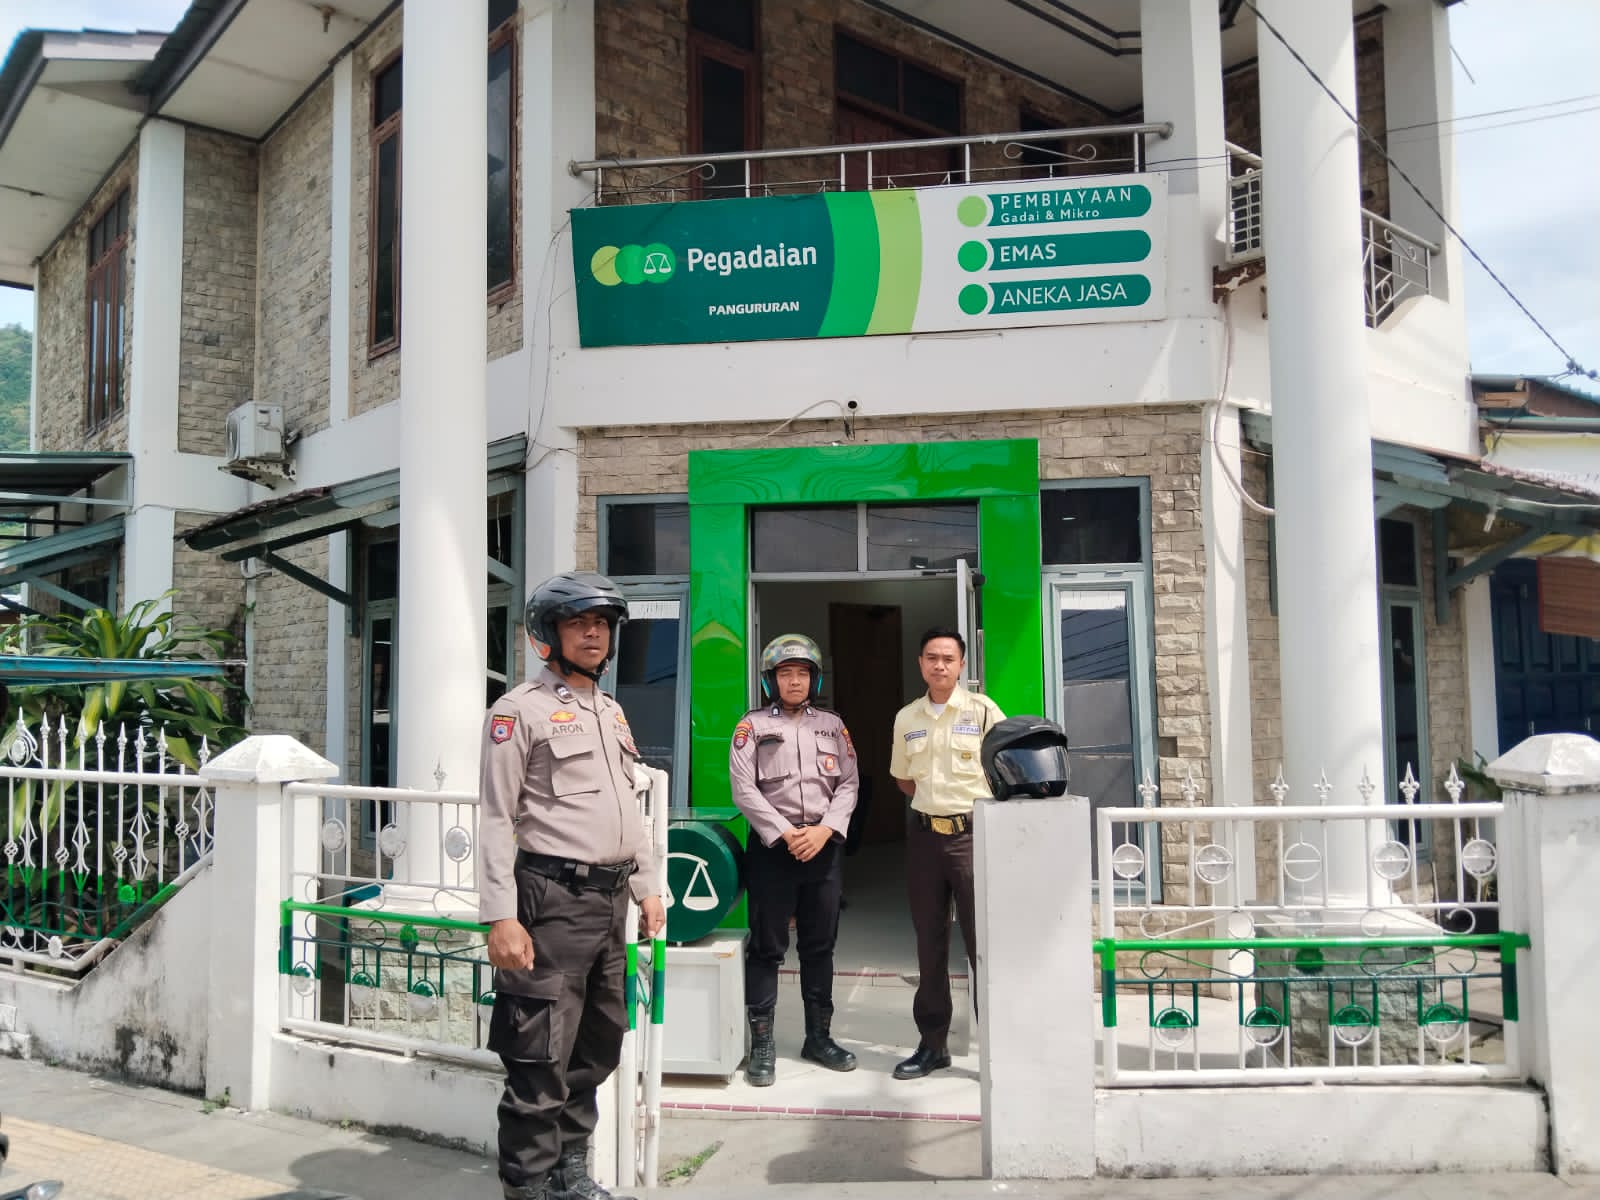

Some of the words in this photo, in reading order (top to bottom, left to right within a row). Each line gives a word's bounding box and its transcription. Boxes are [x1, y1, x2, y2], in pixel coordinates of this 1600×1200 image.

[1000, 187, 1131, 210] PEMBIAYAAN
[1000, 211, 1040, 223] Gadai
[1045, 210, 1054, 220] &
[1060, 208, 1100, 220] Mikro
[687, 242, 817, 276] Pegadaian
[1000, 243, 1057, 263] EMAS
[1000, 285, 1072, 307] ANEKA
[1077, 282, 1128, 302] JASA
[708, 301, 800, 316] PANGURURAN
[552, 723, 584, 736] ARON
